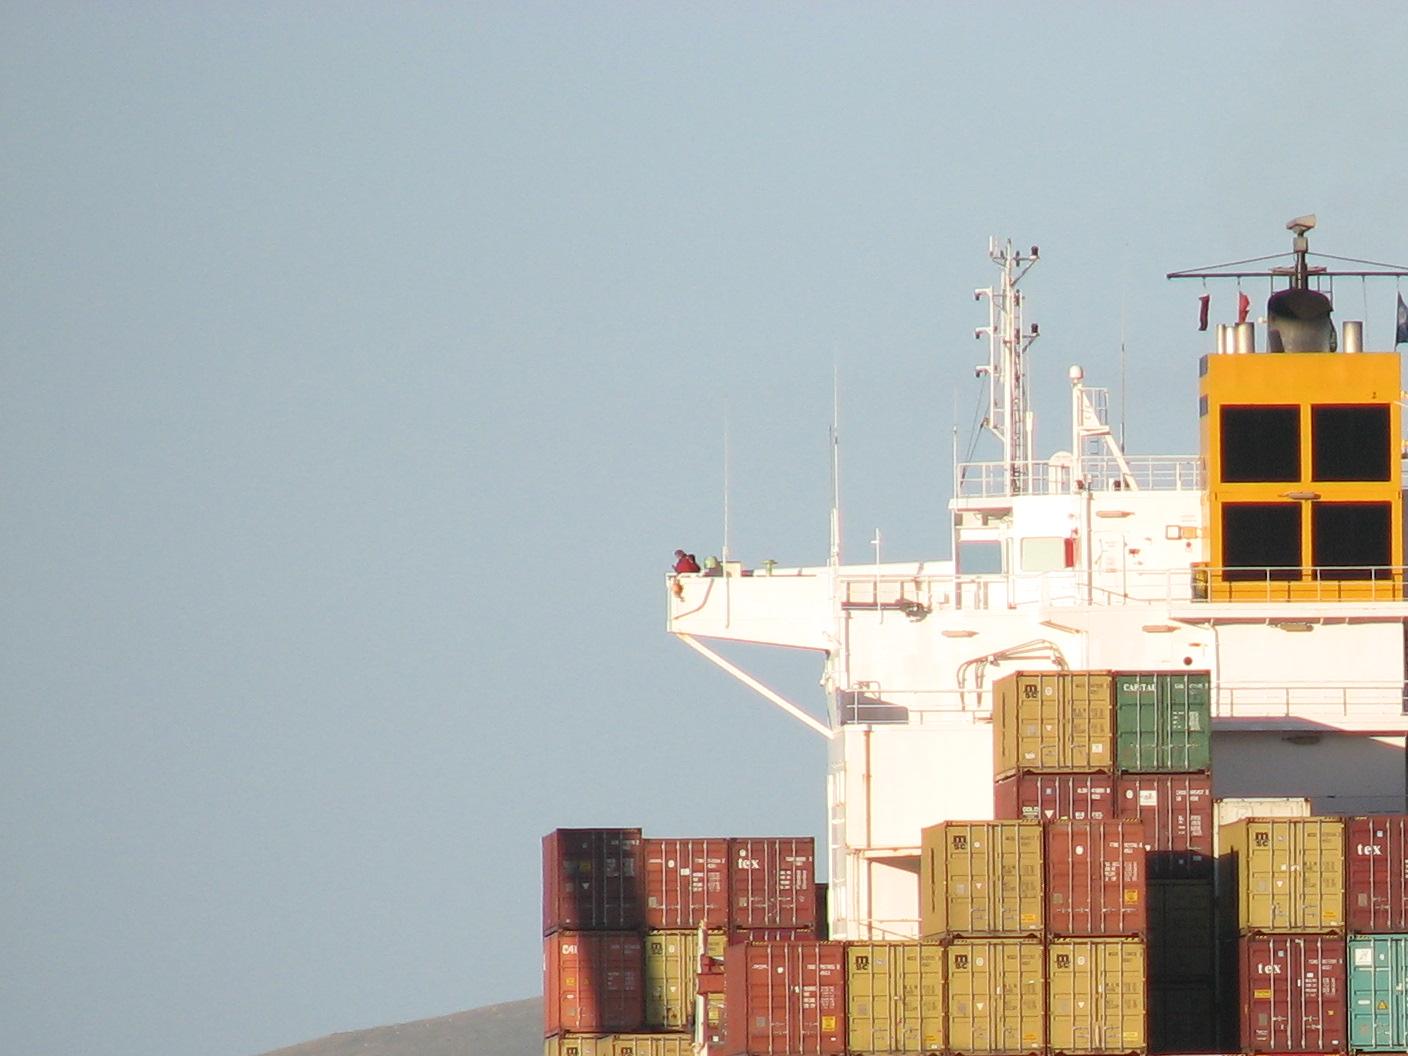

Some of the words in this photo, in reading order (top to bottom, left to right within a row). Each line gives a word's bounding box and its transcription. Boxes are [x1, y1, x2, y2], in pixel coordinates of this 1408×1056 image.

[1357, 843, 1381, 855] tex
[738, 859, 759, 869] tex
[1258, 963, 1281, 974] tex
